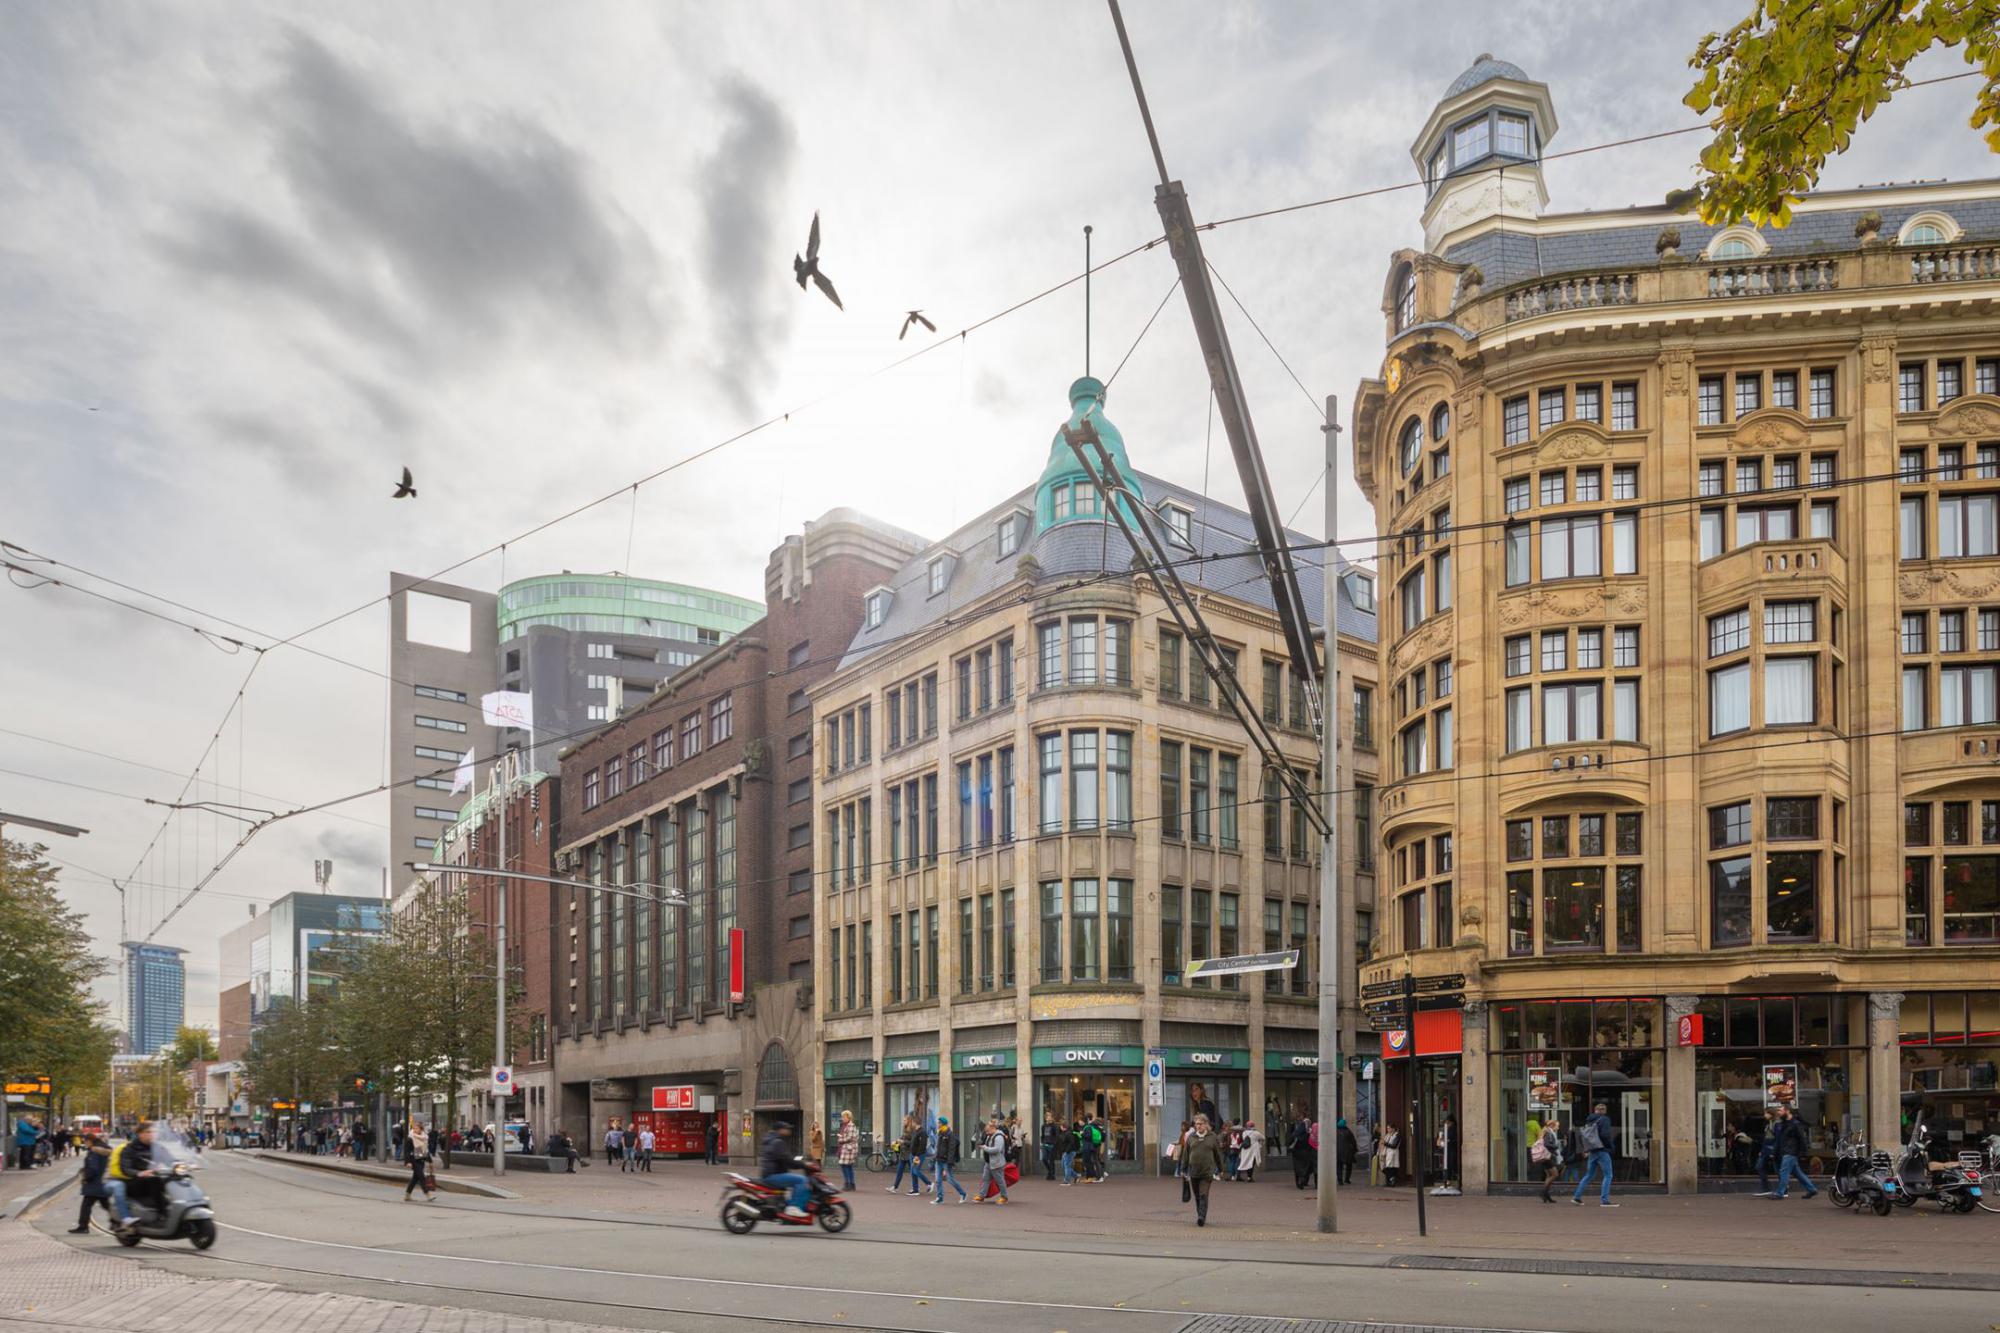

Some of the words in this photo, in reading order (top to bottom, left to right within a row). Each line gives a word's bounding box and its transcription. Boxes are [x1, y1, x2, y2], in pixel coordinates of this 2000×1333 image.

[969, 1055, 993, 1066] ONLY
[1065, 1050, 1105, 1061] ONLY
[1191, 1052, 1222, 1063] ONLY
[1292, 1056, 1320, 1066] ONLY
[898, 1060, 919, 1070] ONLY
